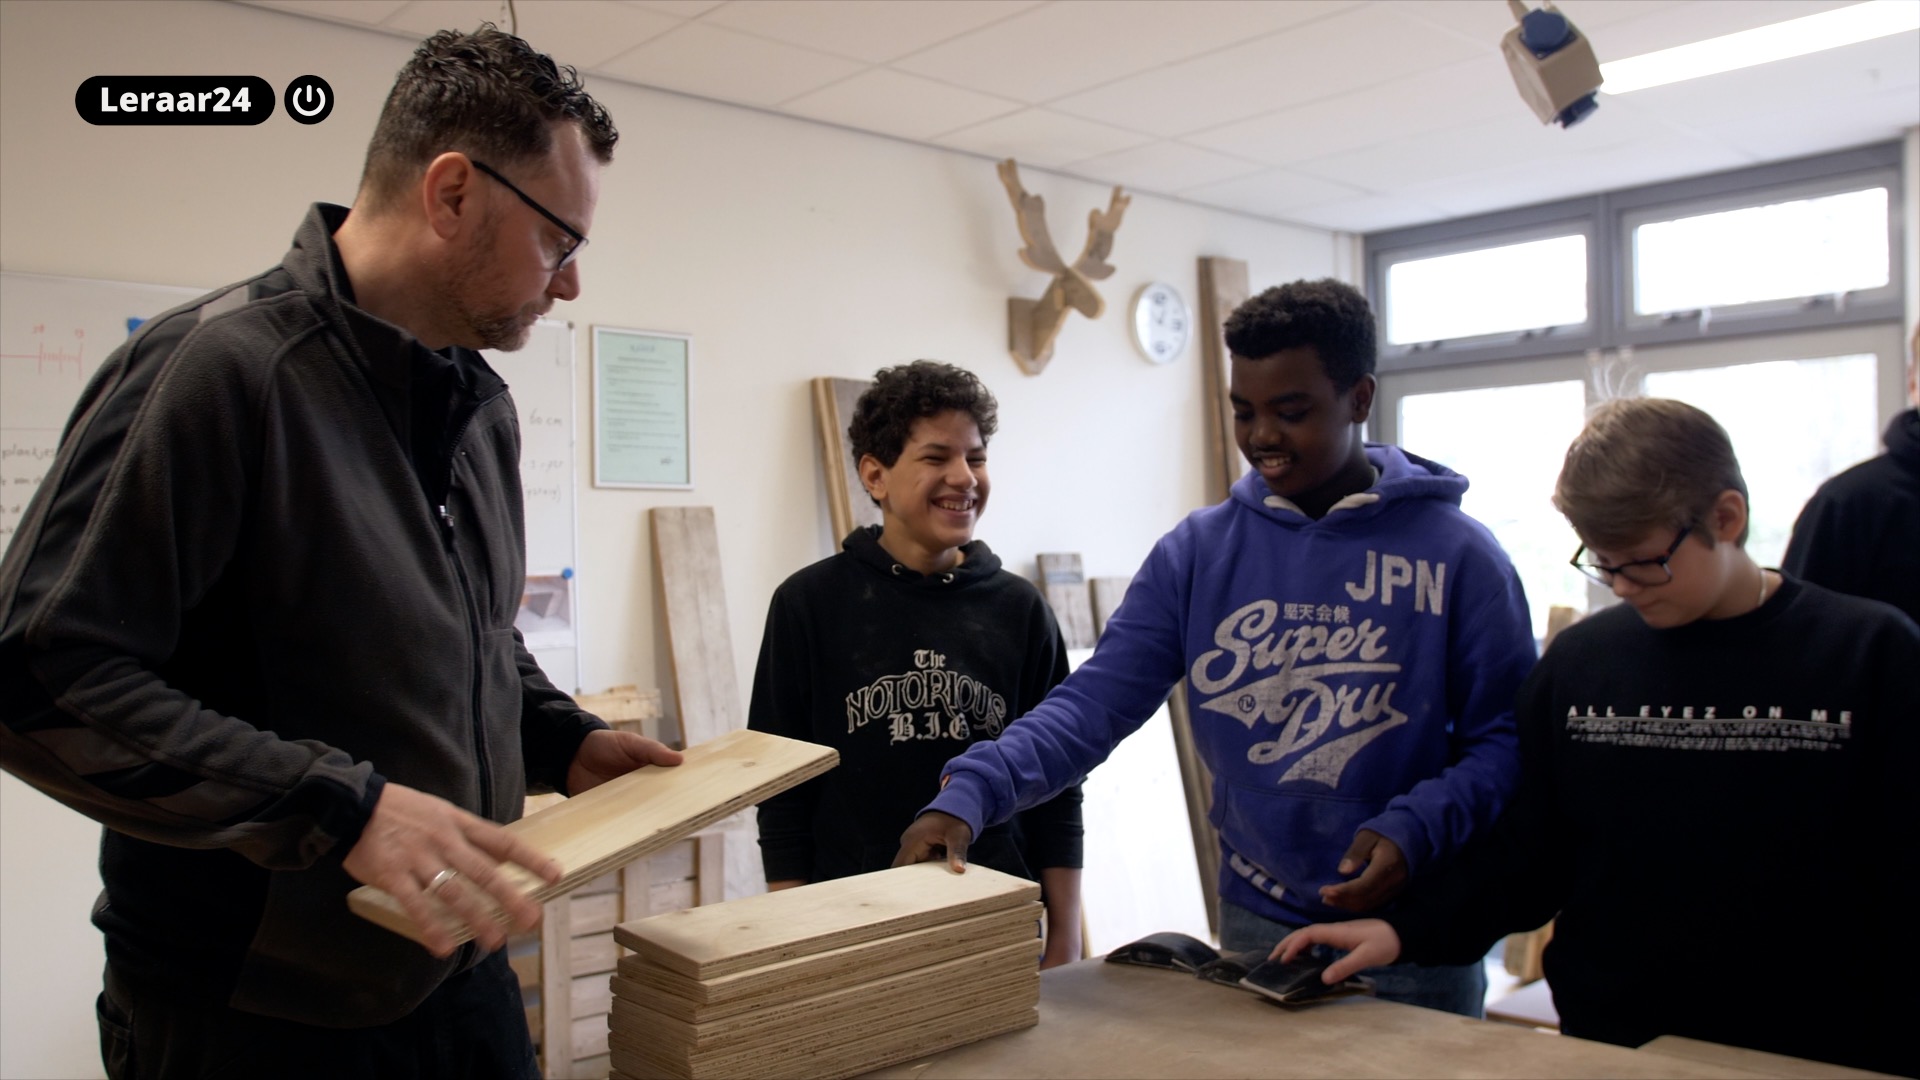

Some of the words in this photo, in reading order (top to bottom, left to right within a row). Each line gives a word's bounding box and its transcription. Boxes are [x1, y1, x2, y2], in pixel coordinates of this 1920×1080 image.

[1345, 550, 1446, 616] JPN
[913, 649, 946, 669] The
[1190, 599, 1389, 695] Super
[846, 669, 1007, 739] NOTORIOUS
[1567, 705, 1616, 718] ALL
[1639, 705, 1716, 720] EYEZ
[1742, 705, 1782, 720] ON
[1811, 709, 1852, 726] ME
